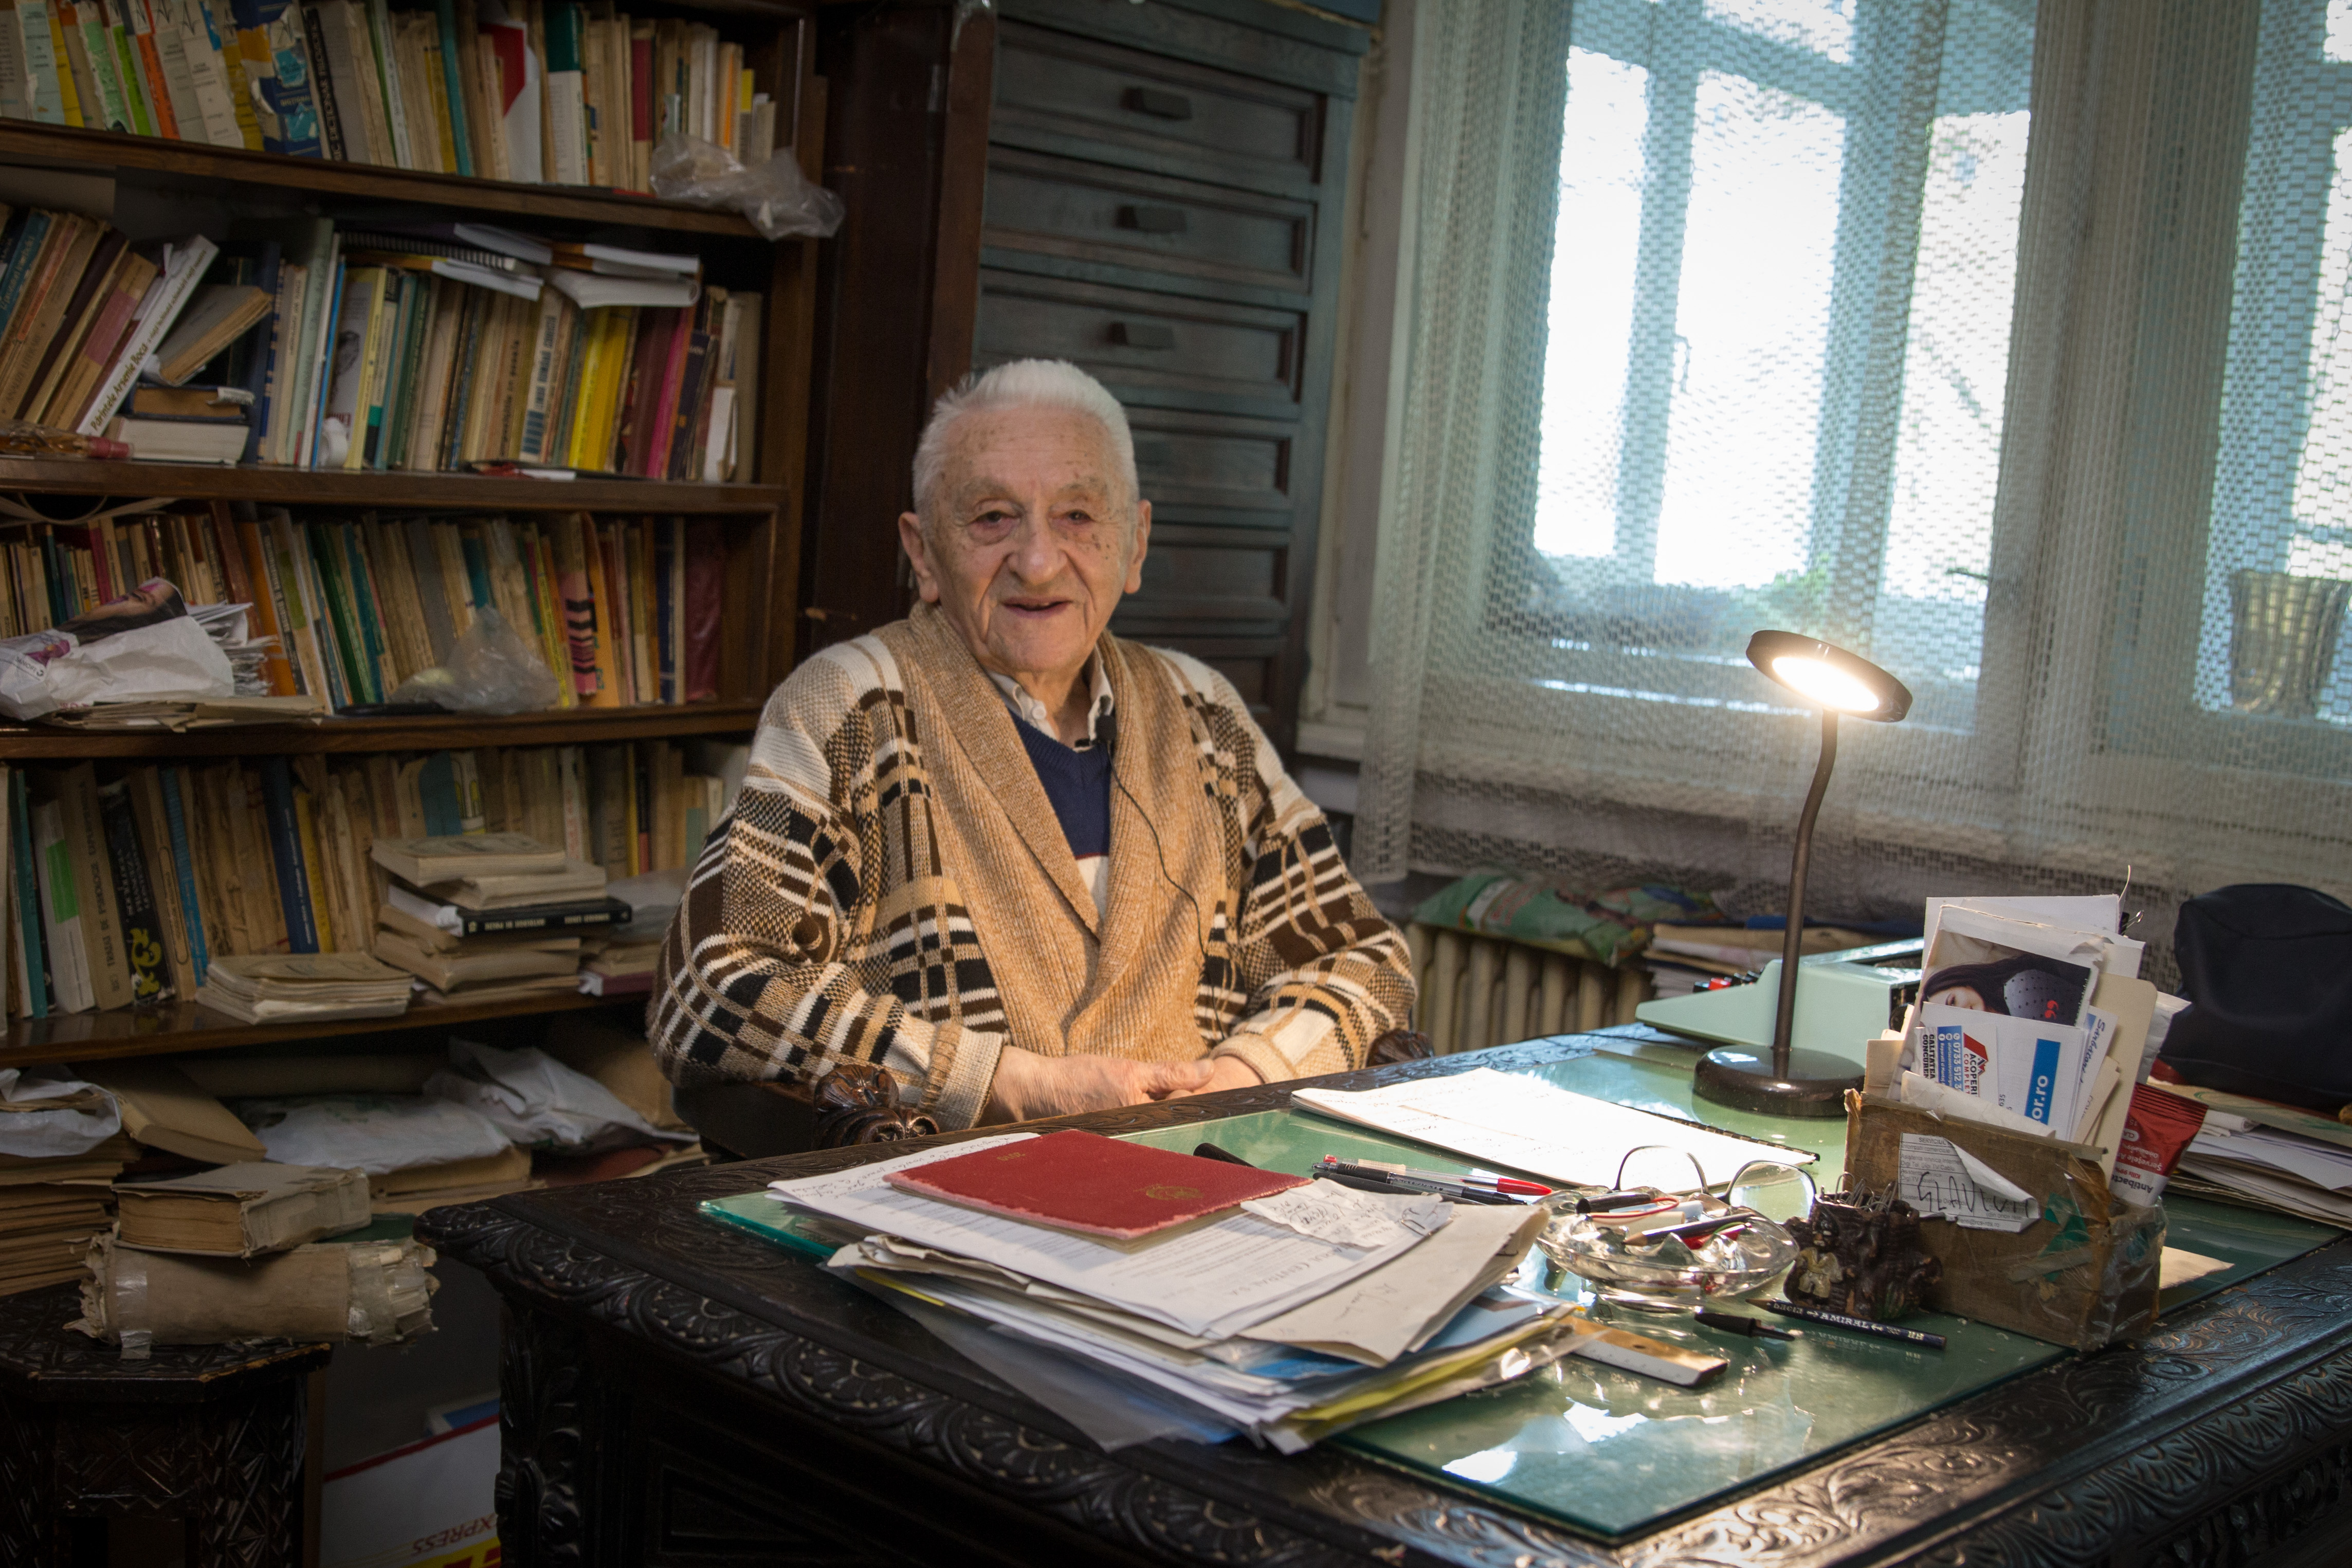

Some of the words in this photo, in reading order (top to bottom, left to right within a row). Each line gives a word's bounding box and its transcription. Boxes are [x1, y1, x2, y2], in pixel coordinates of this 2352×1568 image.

[2031, 1075, 2049, 1119] or.ro
[2129, 1171, 2141, 1179] Kills
[1819, 1312, 1870, 1329] AMIRAL
